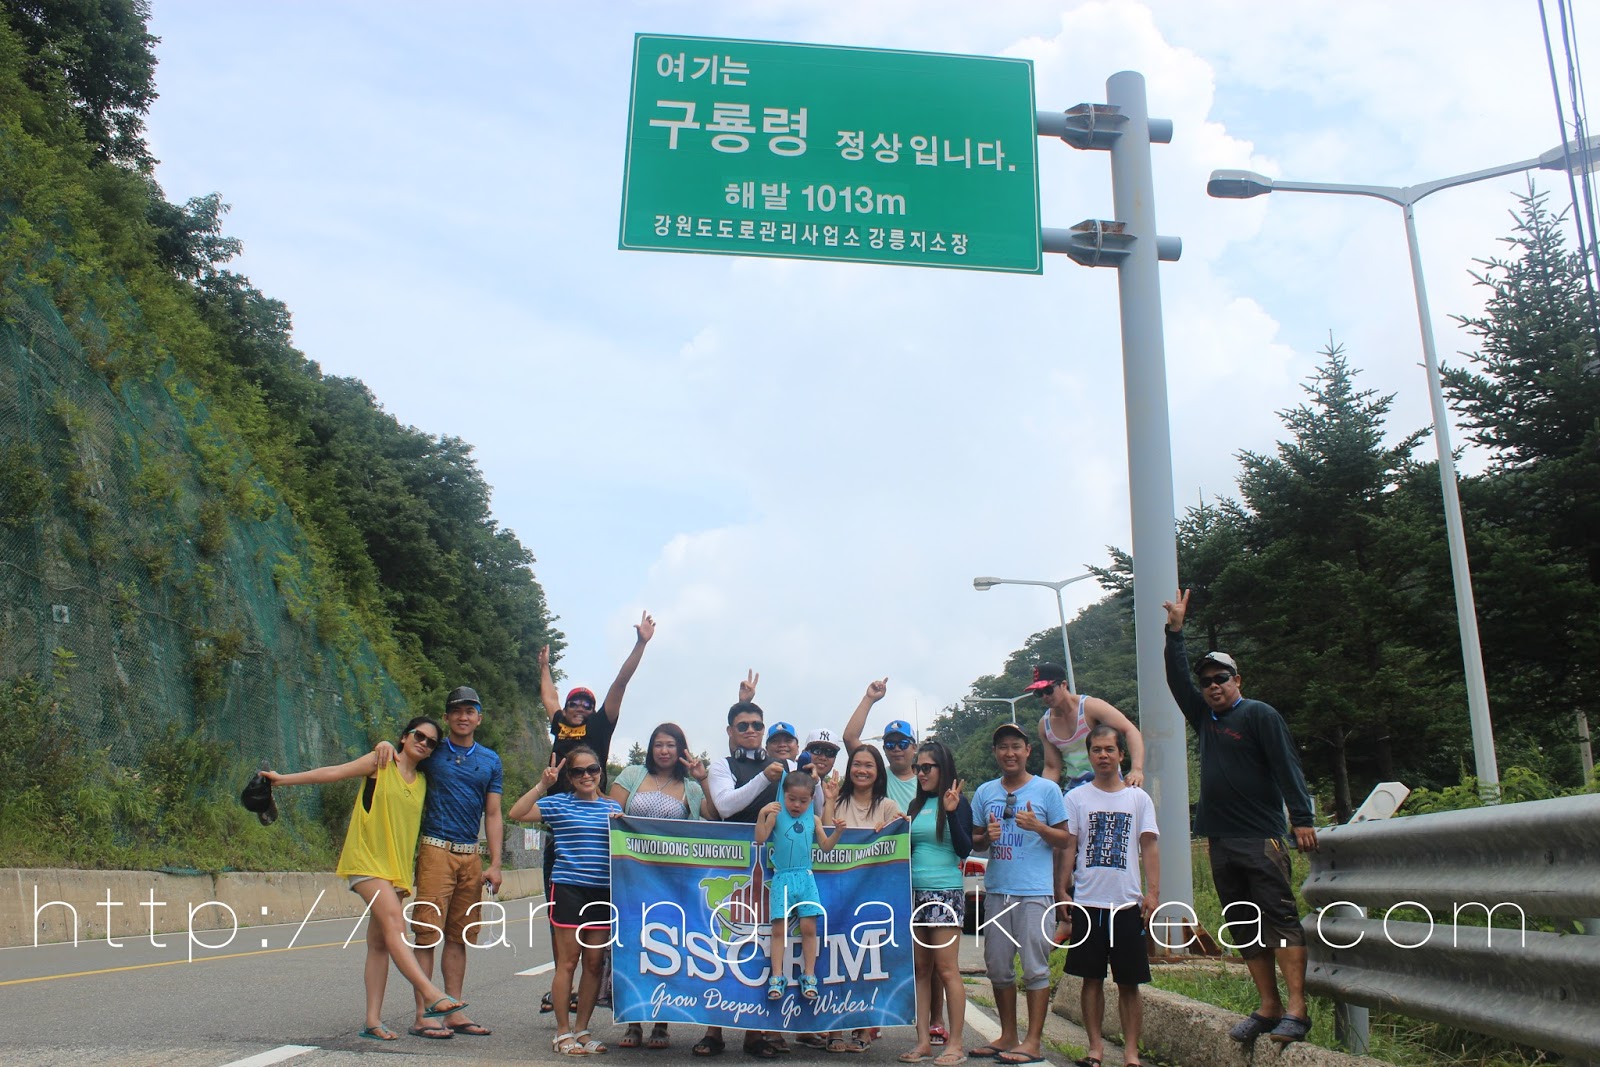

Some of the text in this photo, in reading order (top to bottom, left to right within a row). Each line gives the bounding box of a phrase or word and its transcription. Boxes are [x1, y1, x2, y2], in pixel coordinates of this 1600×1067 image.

[656, 52, 750, 86] 여기는
[649, 99, 808, 156] 구룡령
[725, 181, 906, 215] 해발 1013m
[868, 227, 969, 255] 강릉지소장
[625, 837, 689, 857] SINWOLDONG
[692, 843, 744, 860] SUNGKYUL
[855, 840, 897, 862] MINISTRY
[991, 847, 1012, 860] ESUS
[649, 982, 879, 1028] Grow Deeper, Go Wider!
